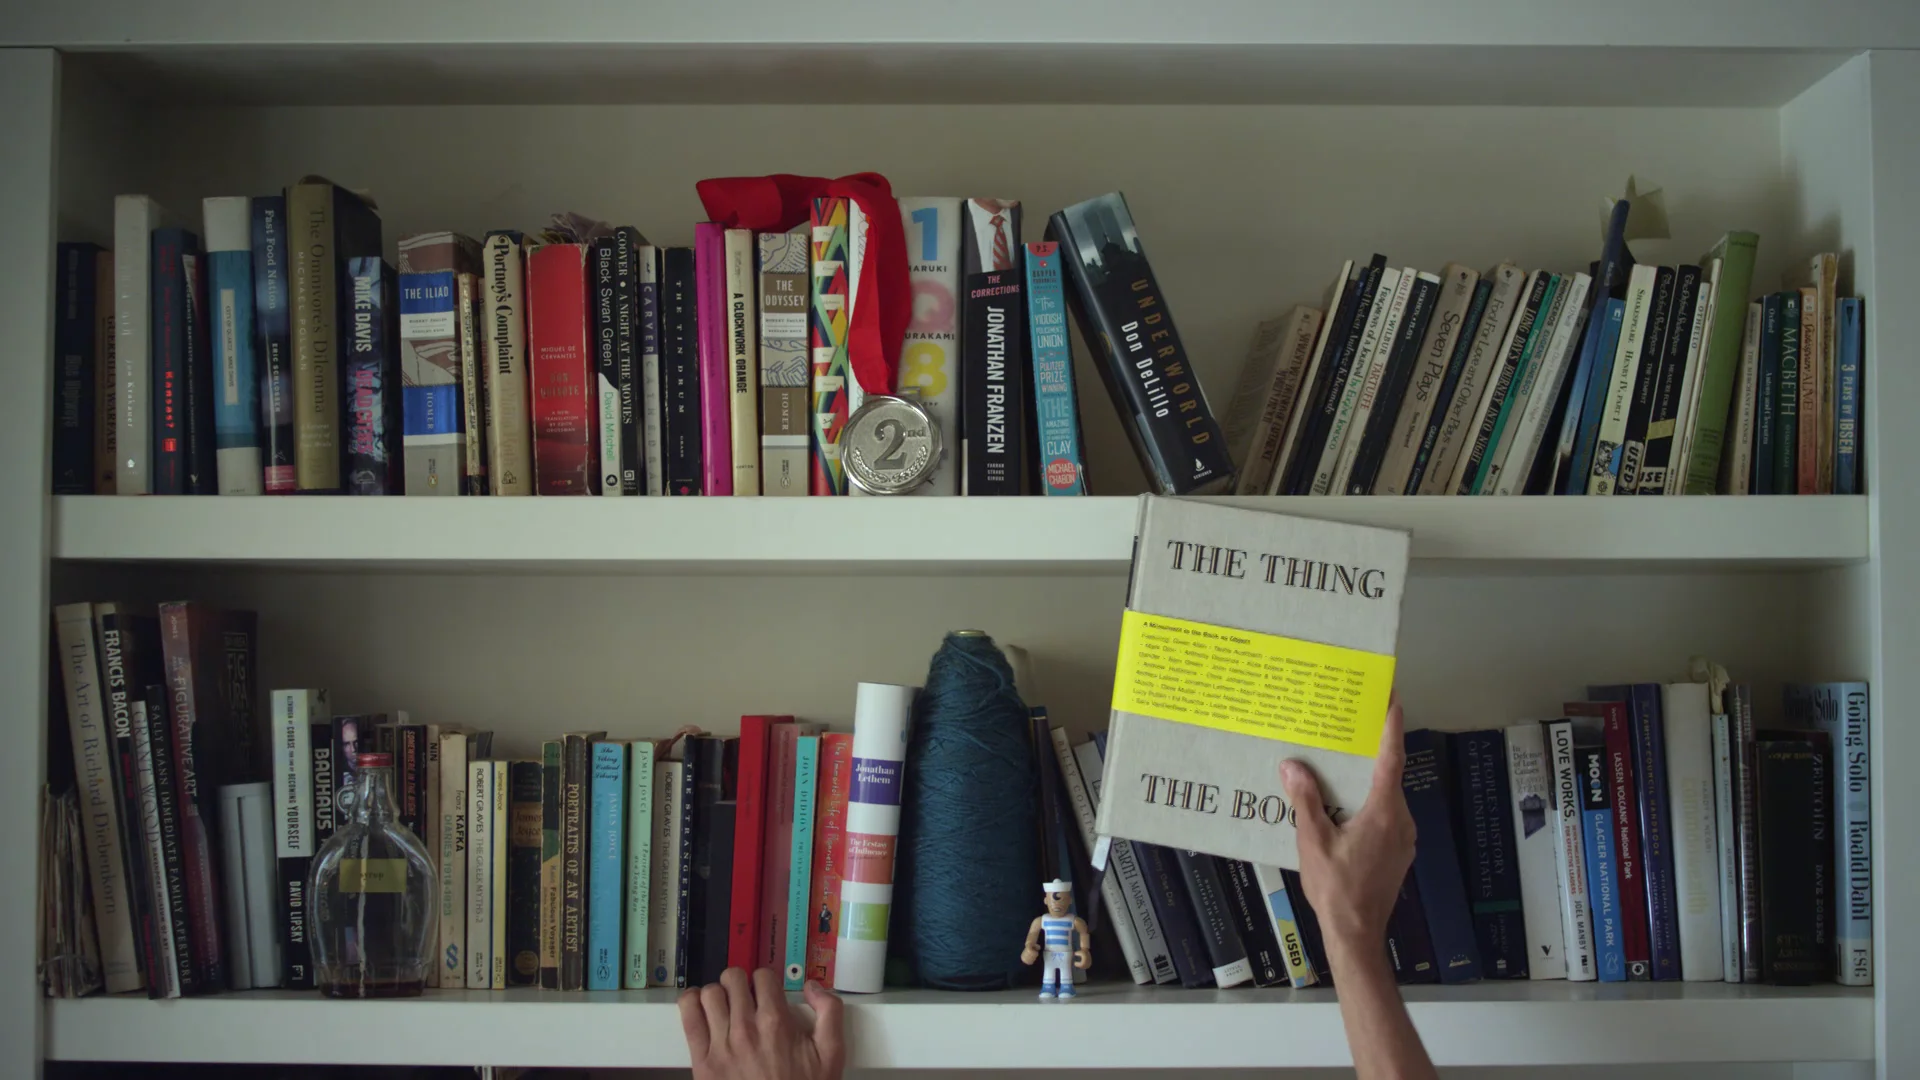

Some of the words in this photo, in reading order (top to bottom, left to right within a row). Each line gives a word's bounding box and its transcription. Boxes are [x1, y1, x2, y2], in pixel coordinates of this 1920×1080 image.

[264, 209, 275, 235] Fast
[309, 207, 326, 240] The
[911, 207, 939, 261] 1
[265, 238, 277, 267] Food
[492, 235, 513, 302] Portnoy's
[600, 248, 612, 284] Black
[617, 231, 628, 277] COOVER
[266, 269, 278, 310] Nation
[298, 251, 308, 311] MICHAEL
[310, 244, 328, 333] Omnivore's
[354, 276, 371, 311] MIKE
[404, 288, 422, 300] THE
[425, 286, 449, 299] ILIAD
[619, 293, 628, 302] A
[776, 280, 793, 291] THE
[970, 284, 1020, 299] CORRECTIONS
[987, 275, 1002, 285] THE
[601, 287, 612, 324] Swan
[765, 295, 805, 306] ODYSSEY
[910, 280, 955, 333] Q
[1035, 296, 1055, 311] The
[1035, 312, 1062, 325] YIDDISH
[1486, 298, 1504, 322] Fool
[1547, 279, 1569, 327] RHINOCEROS
[355, 312, 372, 353] DAVIS
[620, 303, 630, 337] NIGHT
[643, 285, 654, 354] CARVER
[734, 302, 746, 356] CLOCKWORK
[1379, 319, 1397, 356] WILBUR
[1430, 310, 1460, 358] Seven
[1482, 323, 1495, 340] For
[1517, 308, 1537, 332] LONG
[1691, 305, 1704, 349] OTHELLO
[298, 318, 308, 372] POLLAN
[494, 304, 514, 375] Complaint
[602, 328, 614, 367] Green
[621, 339, 630, 354] AT
[987, 306, 1005, 382] JONATHAN
[1037, 335, 1064, 349] UNION
[1470, 340, 1490, 365] Love
[1507, 335, 1526, 361] DAY'S
[1534, 329, 1550, 360] EUGENE
[313, 339, 329, 413] Dilemma
[621, 356, 631, 379] THE
[736, 359, 747, 394] ORANGE
[902, 342, 948, 397] 8
[1040, 371, 1067, 384] PRIZE-
[1121, 320, 1144, 353] Don
[1136, 357, 1170, 419] DeLillo
[1131, 278, 1210, 444] UNDERWORLD
[1465, 367, 1478, 386] and
[1521, 360, 1539, 396] IONESCO
[1781, 327, 1798, 416] MACBETH
[1840, 364, 1856, 372] 3
[357, 369, 373, 408] DEAD
[677, 365, 685, 413] DRUM
[1360, 363, 1384, 410] TARTUFFE
[1416, 360, 1444, 403] Plays
[1491, 363, 1514, 405] JOURNEY
[1841, 376, 1853, 401] PLAYS
[426, 392, 435, 430] HOMER
[604, 391, 615, 420] David
[622, 382, 632, 425] MOVIES
[781, 393, 789, 430] HOMER
[987, 385, 1005, 454] FRANZEN
[1042, 398, 1069, 418] THE
[1452, 388, 1472, 417] Other
[1482, 406, 1498, 431] INTO
[1841, 404, 1852, 415] BY
[358, 409, 374, 454] CITIES
[604, 423, 616, 461] Mitchell
[1046, 440, 1072, 456] CLAY
[1443, 417, 1461, 443] Plays
[1470, 432, 1488, 464] NIGHT
[1839, 418, 1855, 454] IBSEN
[1047, 463, 1075, 474] MICHAEL
[1049, 474, 1075, 485] CHABON
[1623, 446, 1640, 483] USED
[1167, 539, 1248, 580] THE
[1260, 552, 1386, 600] THING
[71, 639, 87, 674] The
[105, 629, 124, 687] FRANCIS
[75, 682, 91, 709] Art
[81, 713, 97, 729] of
[112, 691, 131, 739] BACON
[151, 704, 164, 742] SALLY
[174, 676, 194, 764] FIGURATIVE
[1845, 692, 1867, 748] Going
[1467, 739, 1480, 760] OF
[1555, 729, 1571, 764] LOVE
[83, 738, 107, 807] Richard
[156, 748, 169, 786] MANN
[183, 768, 197, 797] ART
[685, 762, 693, 795] THE
[855, 763, 895, 776] Jonathan
[857, 774, 891, 785] Lethem
[1469, 762, 1482, 791] THE
[1482, 753, 1499, 814] PEOPLE'S
[1588, 753, 1603, 802] MOON
[1613, 751, 1625, 783] LASSEN
[1848, 751, 1867, 793] Solo
[314, 747, 332, 830] BAUHAUS
[1140, 772, 1220, 814] THE
[1230, 788, 1346, 829] BOK
[1559, 767, 1576, 823] WORKS.
[1616, 785, 1628, 825] VOLCANIC
[160, 792, 177, 863] IMMEDIATE
[287, 805, 300, 850] YOURSELF
[455, 814, 465, 852] KAFKA
[515, 810, 542, 822] James
[515, 825, 541, 837] Joyce
[567, 783, 579, 854] PORTRAITS
[1471, 793, 1489, 848] UNITED
[681, 803, 692, 897] STRANGER
[1489, 816, 1506, 876] HISTORY
[1595, 813, 1608, 858] GLACIER
[1620, 826, 1631, 859] National
[1850, 820, 1868, 874] Roald
[93, 812, 116, 915] Diebenkorn
[567, 859, 579, 875] OF
[1477, 851, 1493, 899] STATES
[1623, 860, 1633, 879] Park
[169, 868, 183, 913] FAMILY
[289, 880, 302, 907] DAVID
[567, 880, 579, 899] AN
[1114, 839, 1138, 881] EARTH
[1129, 880, 1145, 910] MARK
[1140, 908, 1158, 940] TWAIN
[1599, 861, 1612, 915] NATIONAL
[1851, 873, 1869, 921] Dahl
[290, 911, 304, 943] LIPSKY
[1574, 899, 1585, 919] JOEL
[566, 906, 578, 953] ARTIST
[1576, 921, 1588, 950] MANBY
[1604, 917, 1615, 947] PARK
[175, 919, 192, 985] APERTURE
[1284, 932, 1302, 968] USED
[1853, 948, 1867, 978] FSG
